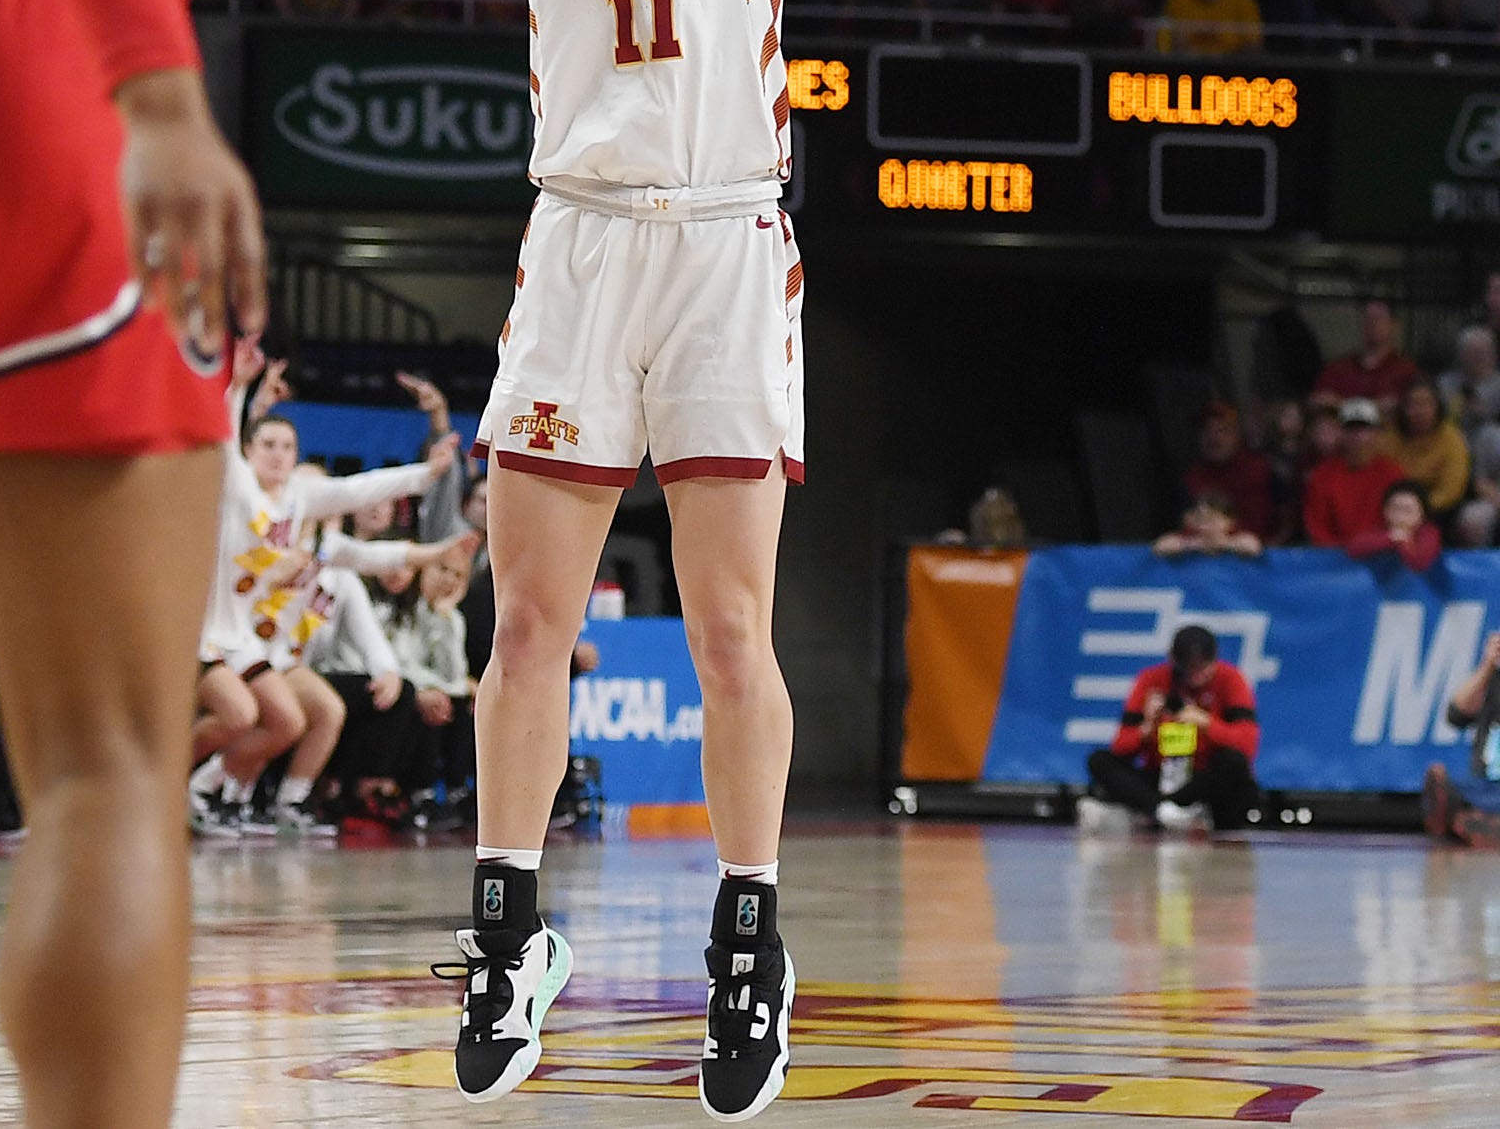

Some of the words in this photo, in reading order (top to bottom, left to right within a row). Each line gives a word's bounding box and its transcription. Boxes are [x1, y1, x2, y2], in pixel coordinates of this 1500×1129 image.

[307, 63, 524, 151] Suku
[1108, 71, 1298, 129] BULLDOGS
[877, 158, 1033, 213] QUARTER
[508, 414, 580, 447] STATE
